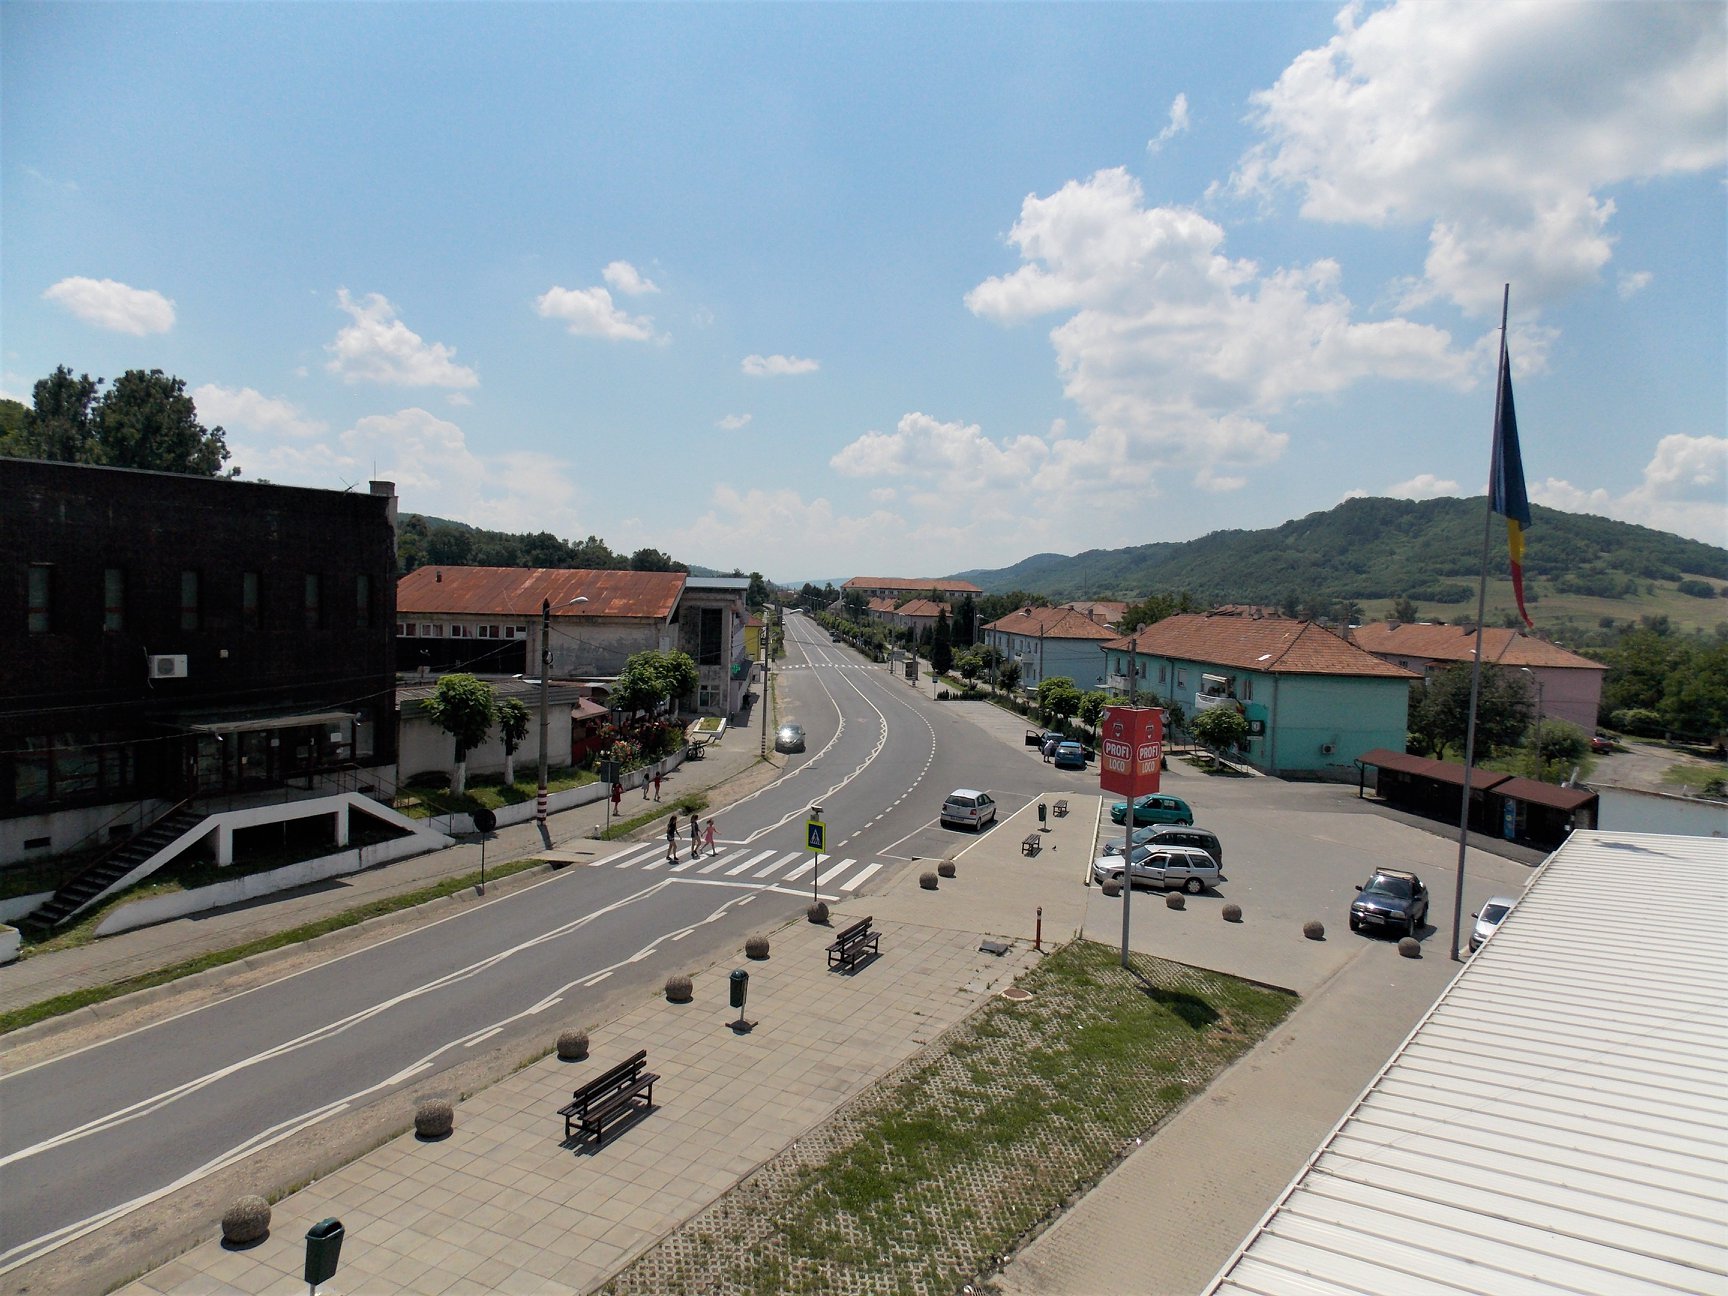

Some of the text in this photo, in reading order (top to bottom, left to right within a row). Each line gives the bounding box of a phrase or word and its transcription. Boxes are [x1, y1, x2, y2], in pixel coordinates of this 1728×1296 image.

[1105, 742, 1129, 758] PROFI
[1139, 745, 1158, 759] PROFI
[1109, 758, 1125, 772] LOCO
[1142, 761, 1155, 773] LOCO
